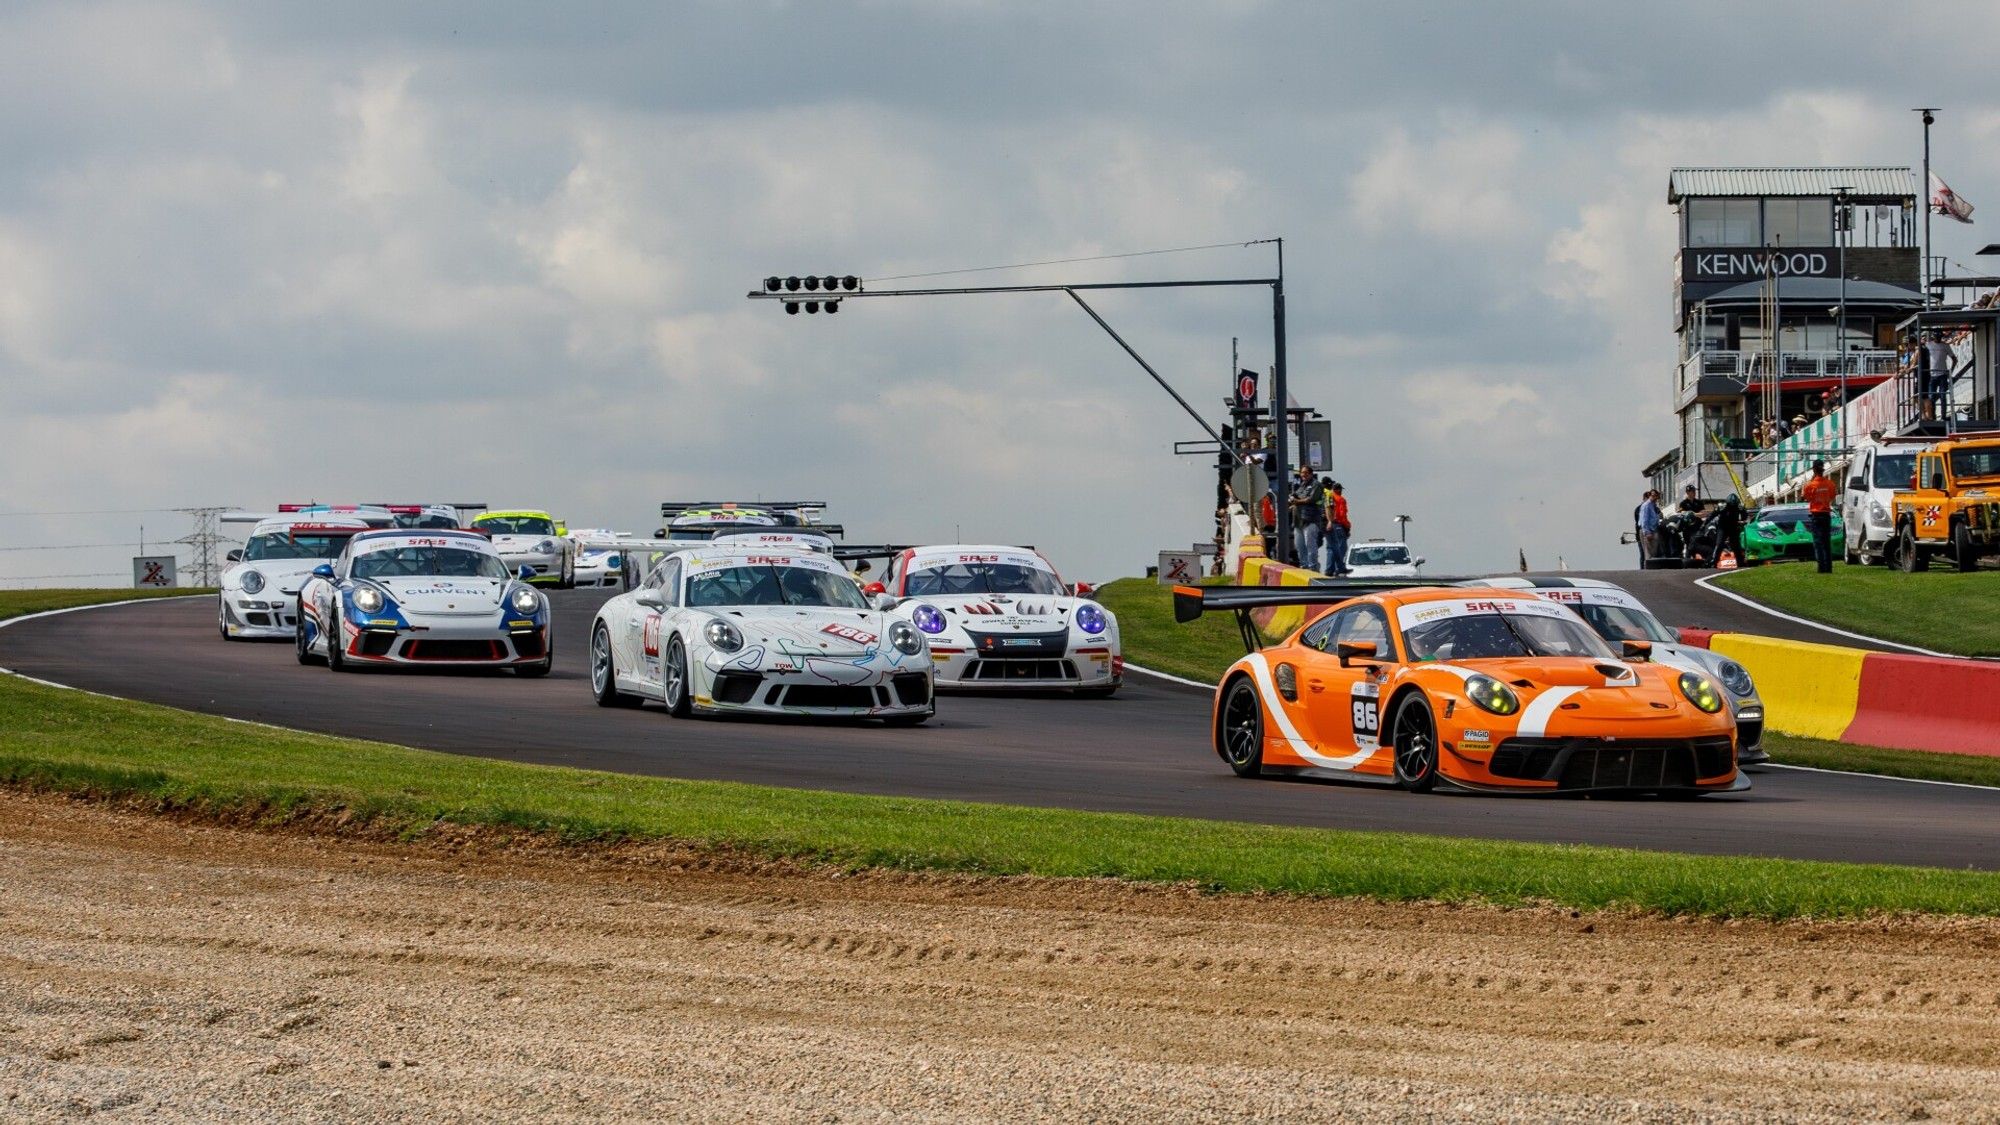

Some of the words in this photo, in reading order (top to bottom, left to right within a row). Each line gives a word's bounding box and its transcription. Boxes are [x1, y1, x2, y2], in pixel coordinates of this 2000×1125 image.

[1697, 254, 1827, 275] KENWOOD
[828, 623, 874, 642] 786
[1352, 701, 1378, 731] 86
